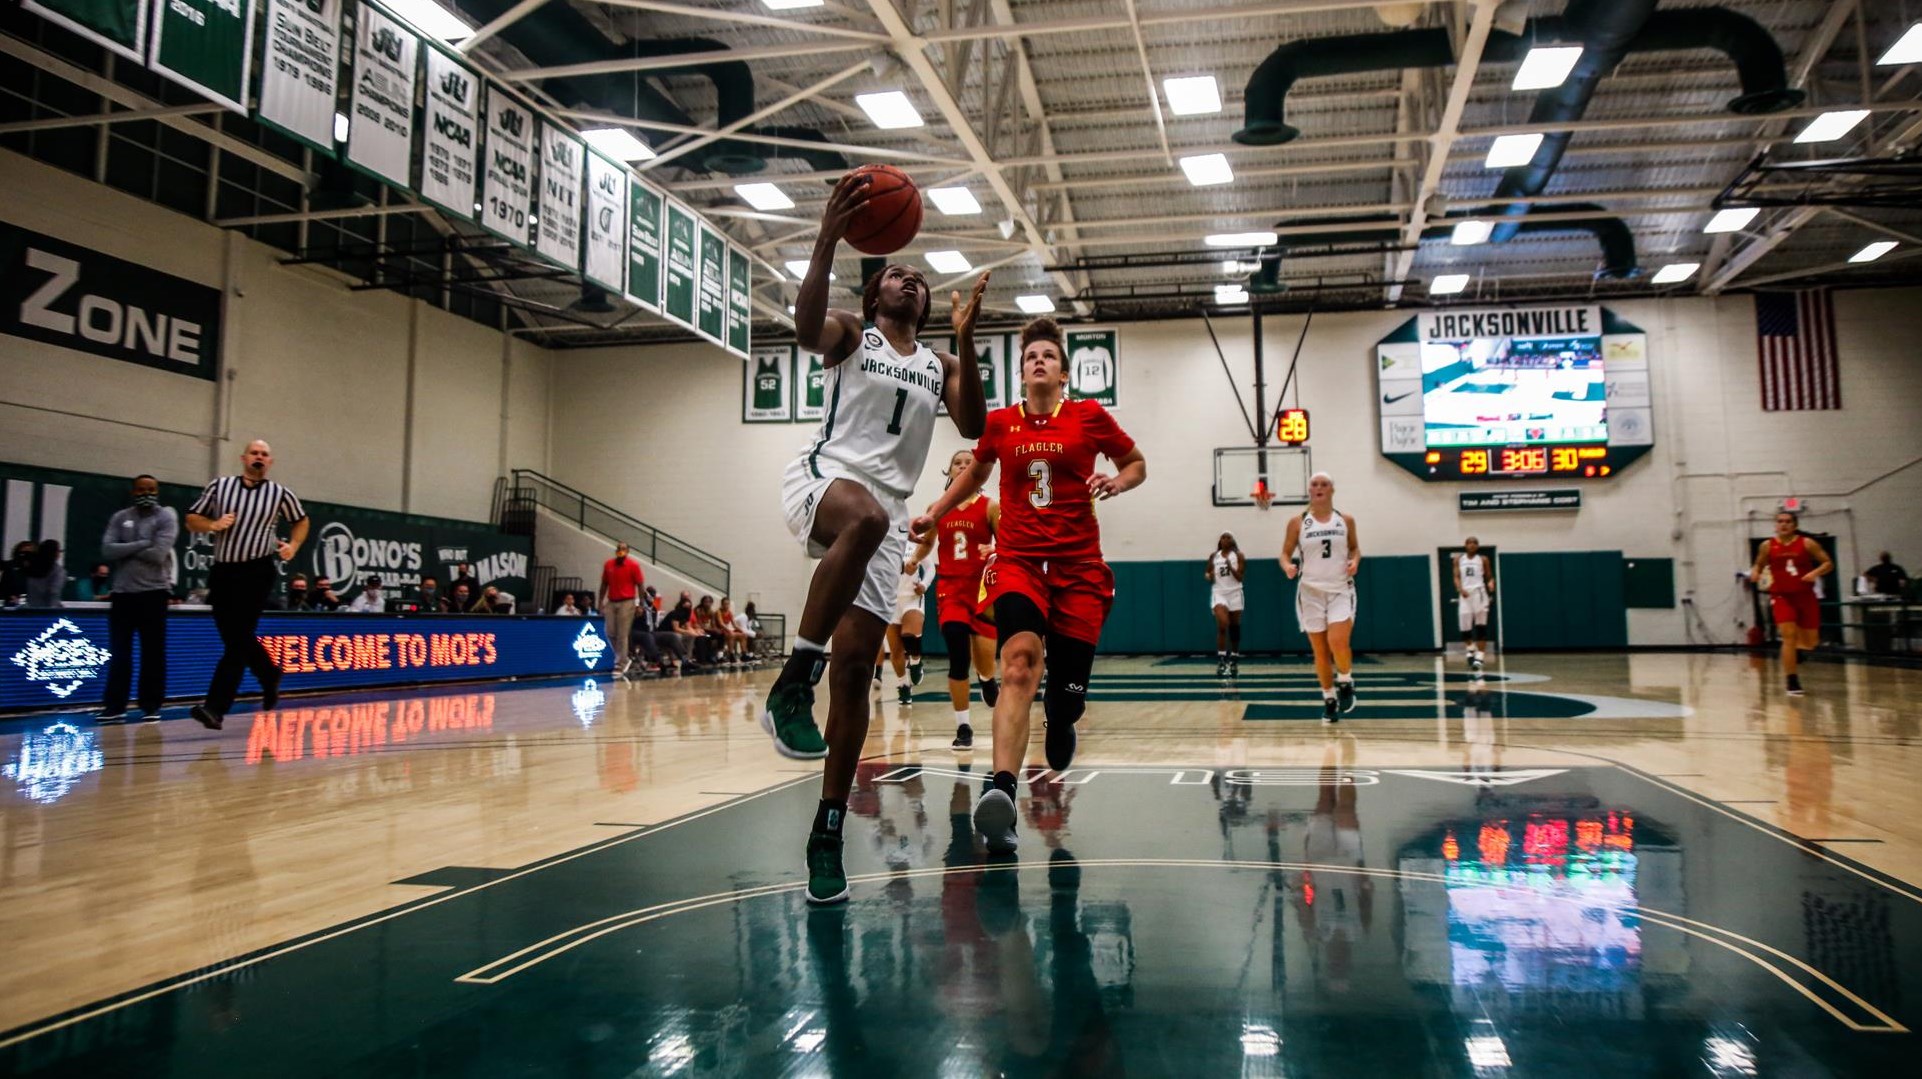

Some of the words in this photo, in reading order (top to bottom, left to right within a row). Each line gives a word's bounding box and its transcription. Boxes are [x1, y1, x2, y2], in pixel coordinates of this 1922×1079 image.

[272, 39, 333, 80] CHAMPIONS
[359, 83, 409, 119] CHAMPIONS
[433, 111, 471, 150] NCAA
[494, 149, 526, 184] NCAA
[547, 177, 576, 207] NIT
[489, 196, 524, 228] 1970
[20, 247, 201, 365] ZONE
[1430, 306, 1589, 338] JACKSONVILLE
[760, 379, 777, 390] 52
[861, 358, 941, 396] JACKSONVILLE
[1086, 365, 1100, 376] 12
[887, 388, 908, 435] 1
[1280, 419, 1307, 441] 28
[1015, 441, 1064, 457] FLAGLER
[1460, 450, 1488, 474] 29
[1502, 449, 1546, 472] 3:06
[1552, 448, 1579, 471] 30
[1028, 458, 1053, 509] 3
[946, 519, 975, 531] FLAGLER
[322, 533, 422, 584] BONO'S
[953, 531, 968, 560] 2
[1321, 539, 1332, 559] 3
[475, 551, 528, 586] MASON
[1785, 559, 1799, 577] 4
[393, 633, 427, 668] TO
[430, 633, 497, 667] MOE'S
